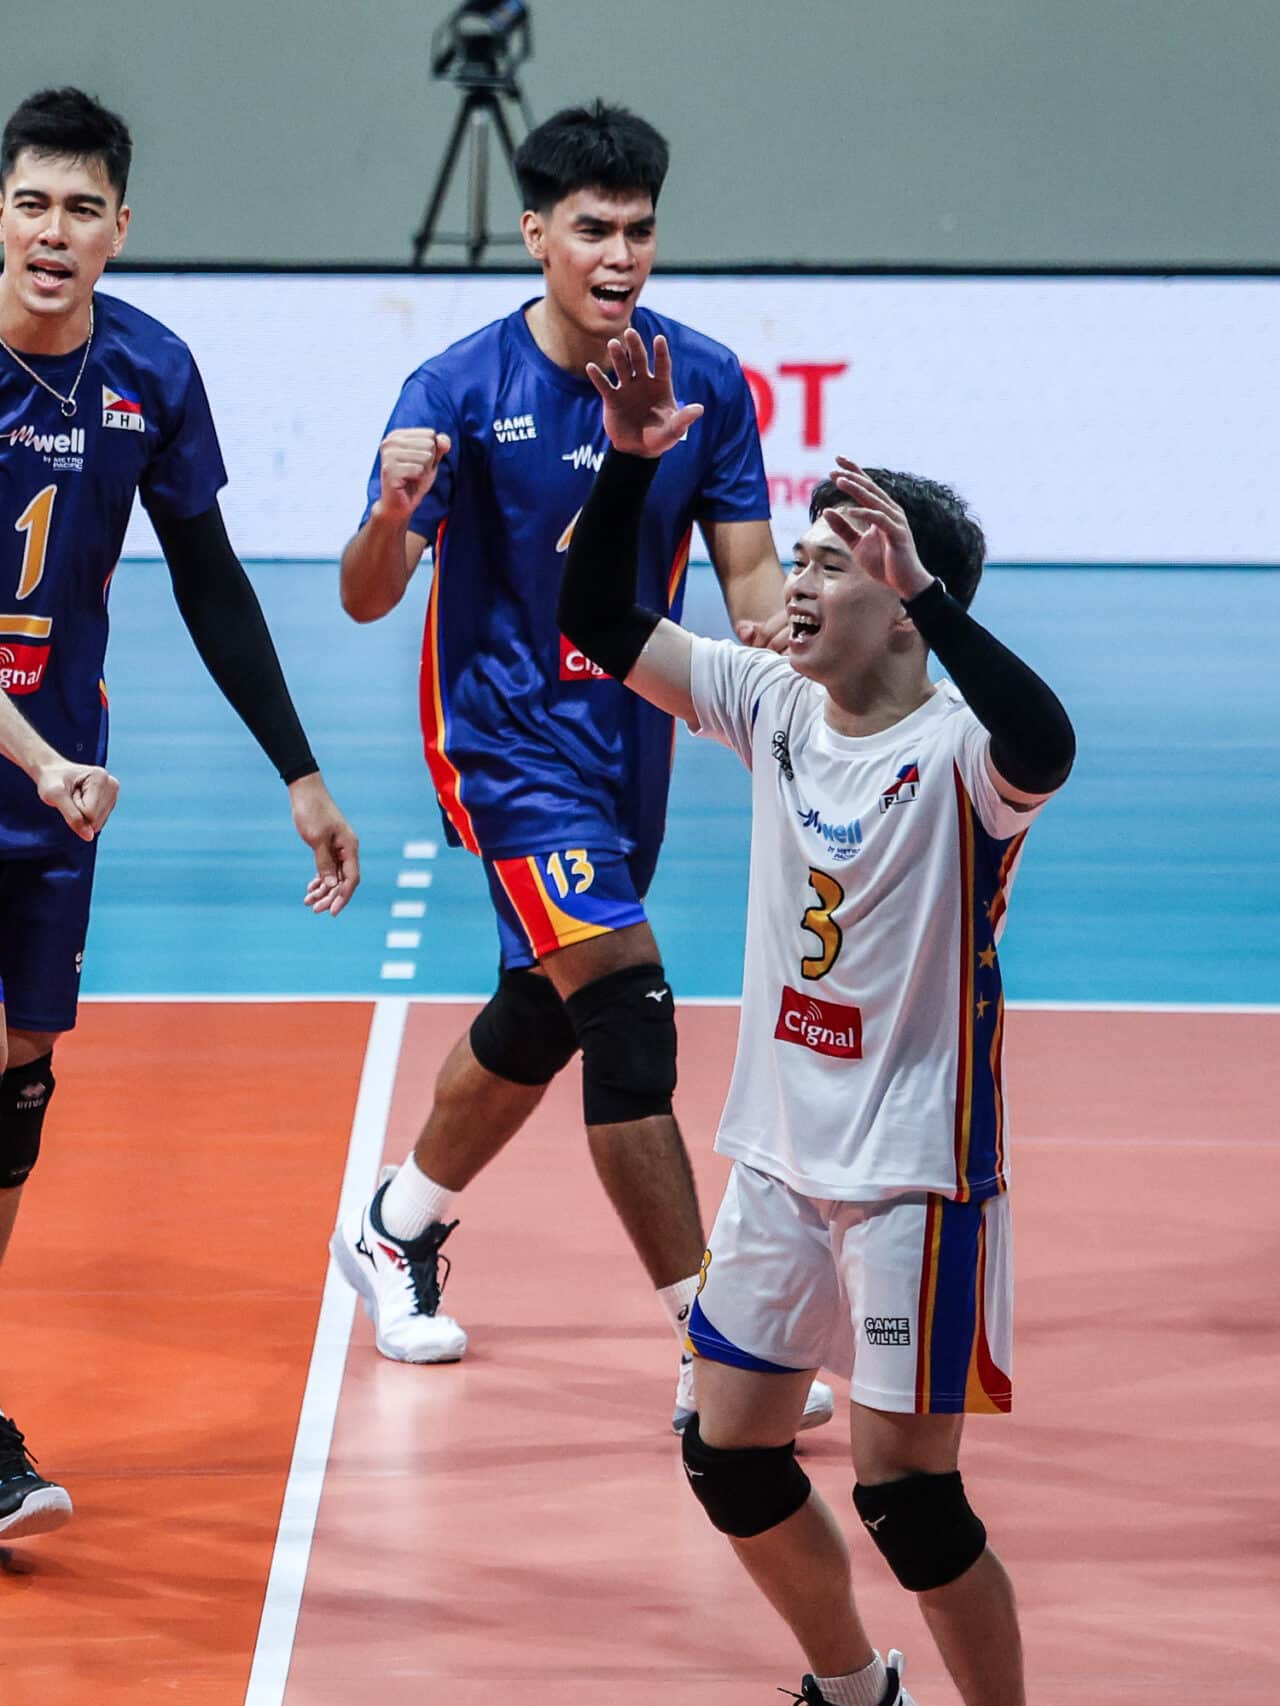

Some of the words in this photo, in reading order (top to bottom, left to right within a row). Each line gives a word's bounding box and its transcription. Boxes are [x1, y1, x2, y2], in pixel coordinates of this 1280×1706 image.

[105, 413, 143, 430] PHI
[493, 415, 534, 431] GAME
[496, 427, 537, 443] VILLE
[15, 485, 57, 600] 1
[547, 849, 596, 898] 13
[800, 866, 845, 981] 3
[783, 1008, 855, 1050] Cignal
[864, 1317, 910, 1331] GAME
[866, 1330, 911, 1346] VILLE
